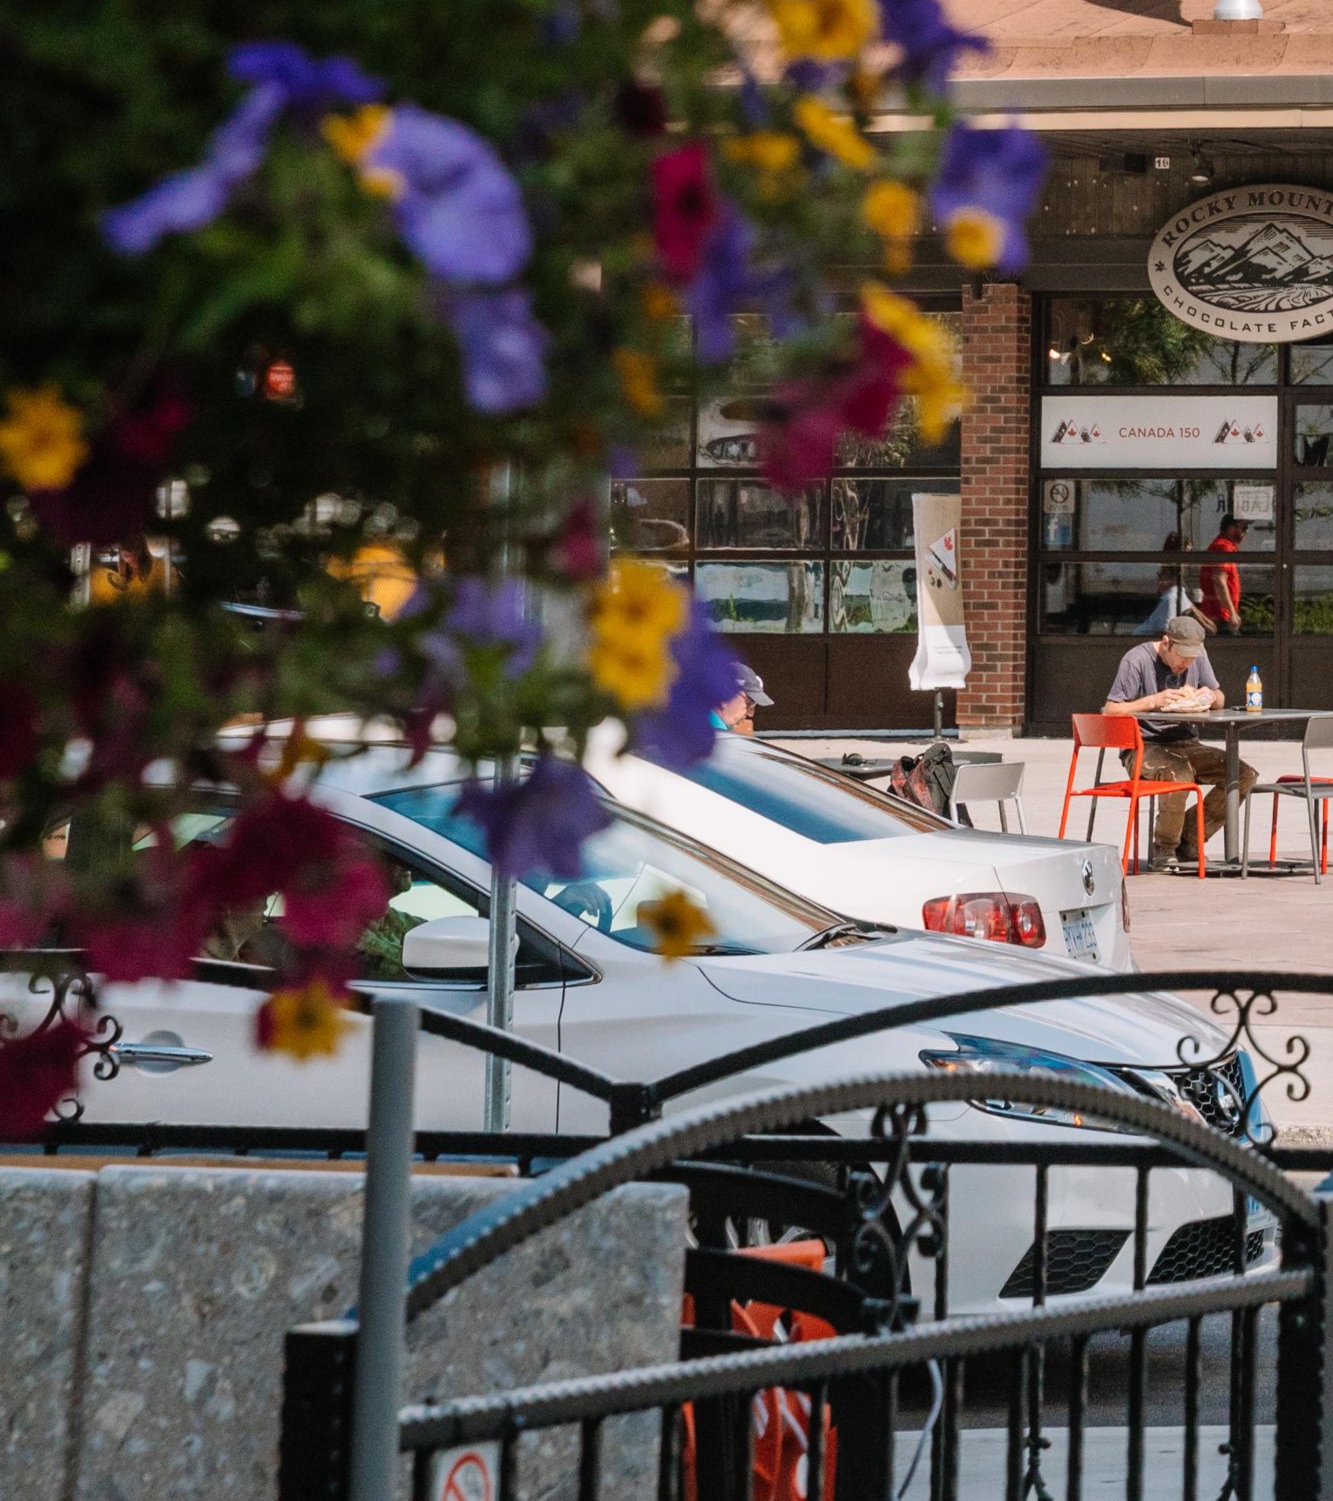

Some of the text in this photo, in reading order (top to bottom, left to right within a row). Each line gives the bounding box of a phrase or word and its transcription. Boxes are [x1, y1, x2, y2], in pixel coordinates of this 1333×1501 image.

[1160, 193, 1238, 249] ROCKY
[1163, 284, 1277, 334] CHOCOLATE
[1118, 427, 1200, 438] CANADA 150
